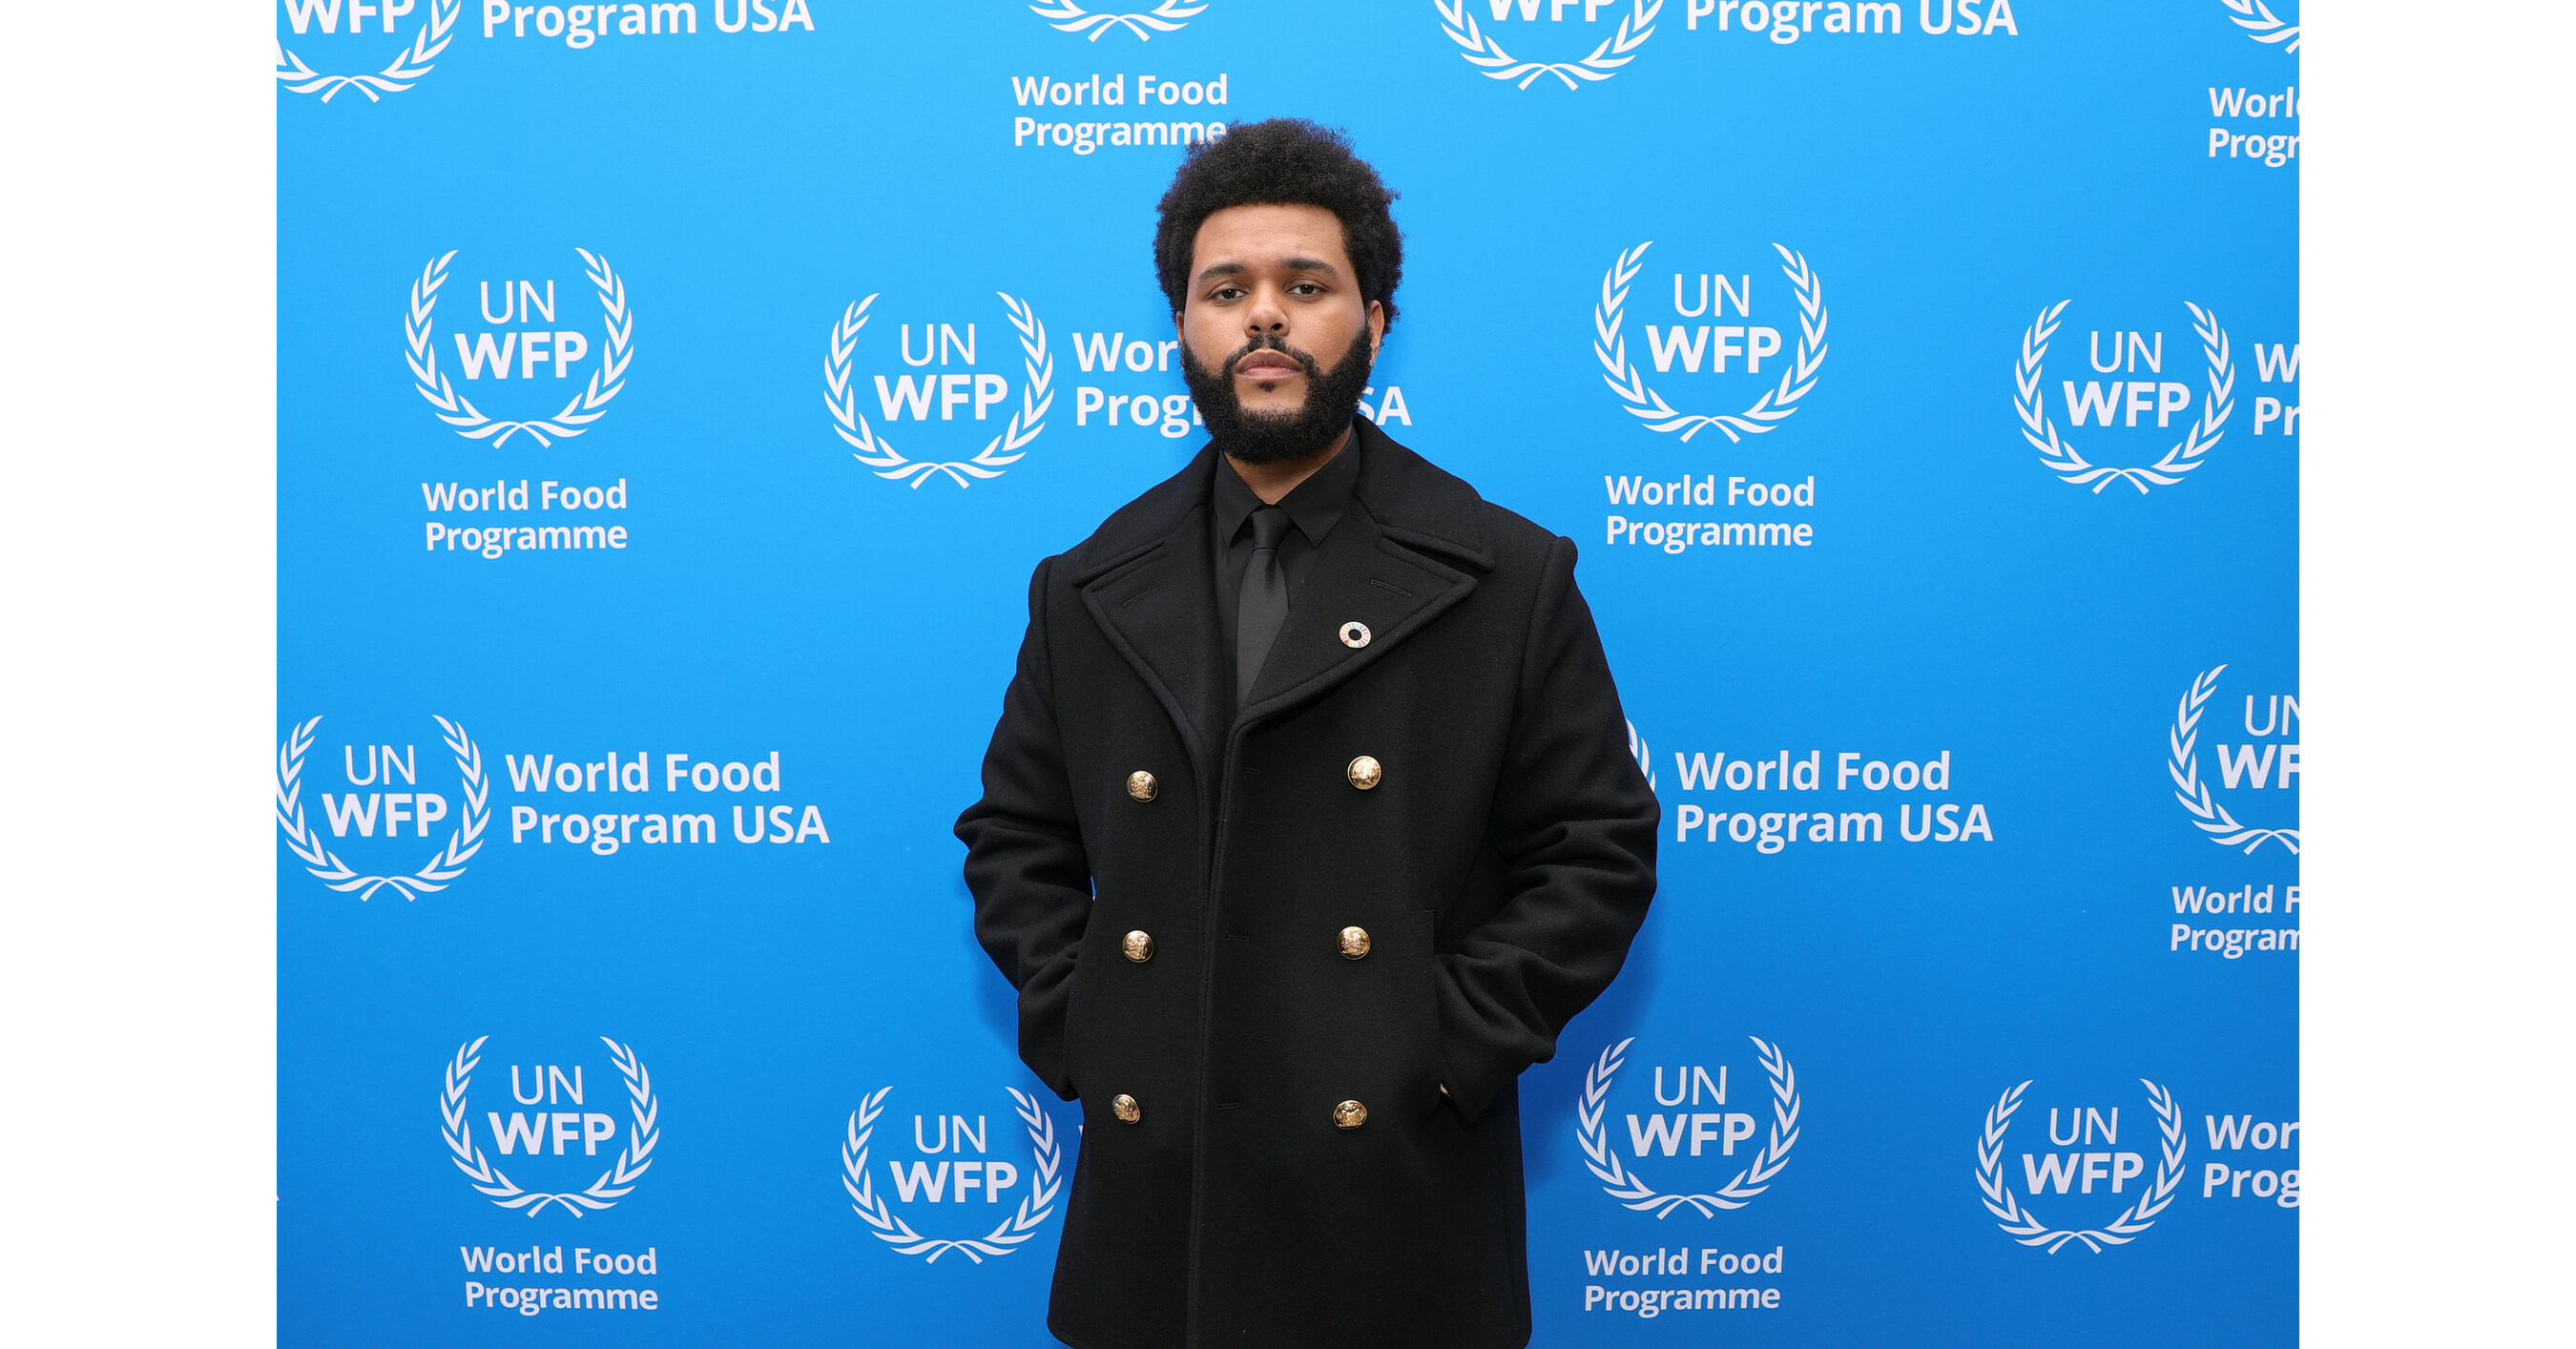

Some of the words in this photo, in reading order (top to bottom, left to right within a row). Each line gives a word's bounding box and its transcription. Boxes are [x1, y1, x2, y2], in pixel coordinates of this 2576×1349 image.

[284, 0, 415, 34] WFP
[483, 0, 696, 49] Program
[715, 0, 815, 32] USA
[1688, 0, 1901, 44] Program
[1920, 0, 2018, 35] USA
[1011, 73, 1124, 106] World
[1138, 73, 1227, 105] Food
[2209, 87, 2299, 117] Worl
[1015, 116, 1228, 156] Programme
[481, 280, 554, 324] UN
[1674, 274, 1750, 317] UN
[454, 331, 588, 380] WFP
[902, 323, 975, 366] UN
[1646, 325, 1781, 373] WFP
[2090, 331, 2162, 373] UN
[874, 374, 1008, 421] WFP
[2063, 381, 2191, 427] WFP
[422, 480, 529, 511] World
[542, 478, 627, 509] Food
[1605, 474, 1714, 506] World
[1729, 476, 1814, 507] Food
[426, 523, 628, 559] Programme
[1608, 516, 1813, 554] Programme
[345, 745, 415, 785] UN
[506, 752, 649, 792] World
[667, 752, 779, 792] Food
[1675, 750, 1819, 790] World
[1838, 751, 1949, 790] Food
[322, 794, 447, 837] WFP
[512, 806, 716, 855] Program
[734, 805, 830, 843] USA
[1677, 805, 1882, 854] Program
[1901, 804, 1993, 841] USA
[2172, 884, 2274, 913] World
[511, 1066, 583, 1105] UN
[1655, 1067, 1726, 1106] UN
[488, 1112, 615, 1155] WFP
[915, 1115, 986, 1153] UN
[1627, 1113, 1755, 1156] WFP
[2050, 1108, 2118, 1146] UN
[889, 1161, 1017, 1203] WFP
[2023, 1152, 2143, 1193] WFP
[461, 1246, 563, 1273] World
[575, 1248, 656, 1275] Food
[1585, 1248, 1688, 1276] World
[1701, 1246, 1782, 1274] Food
[466, 1282, 658, 1316] Programme
[1586, 1286, 1780, 1318] Programme
